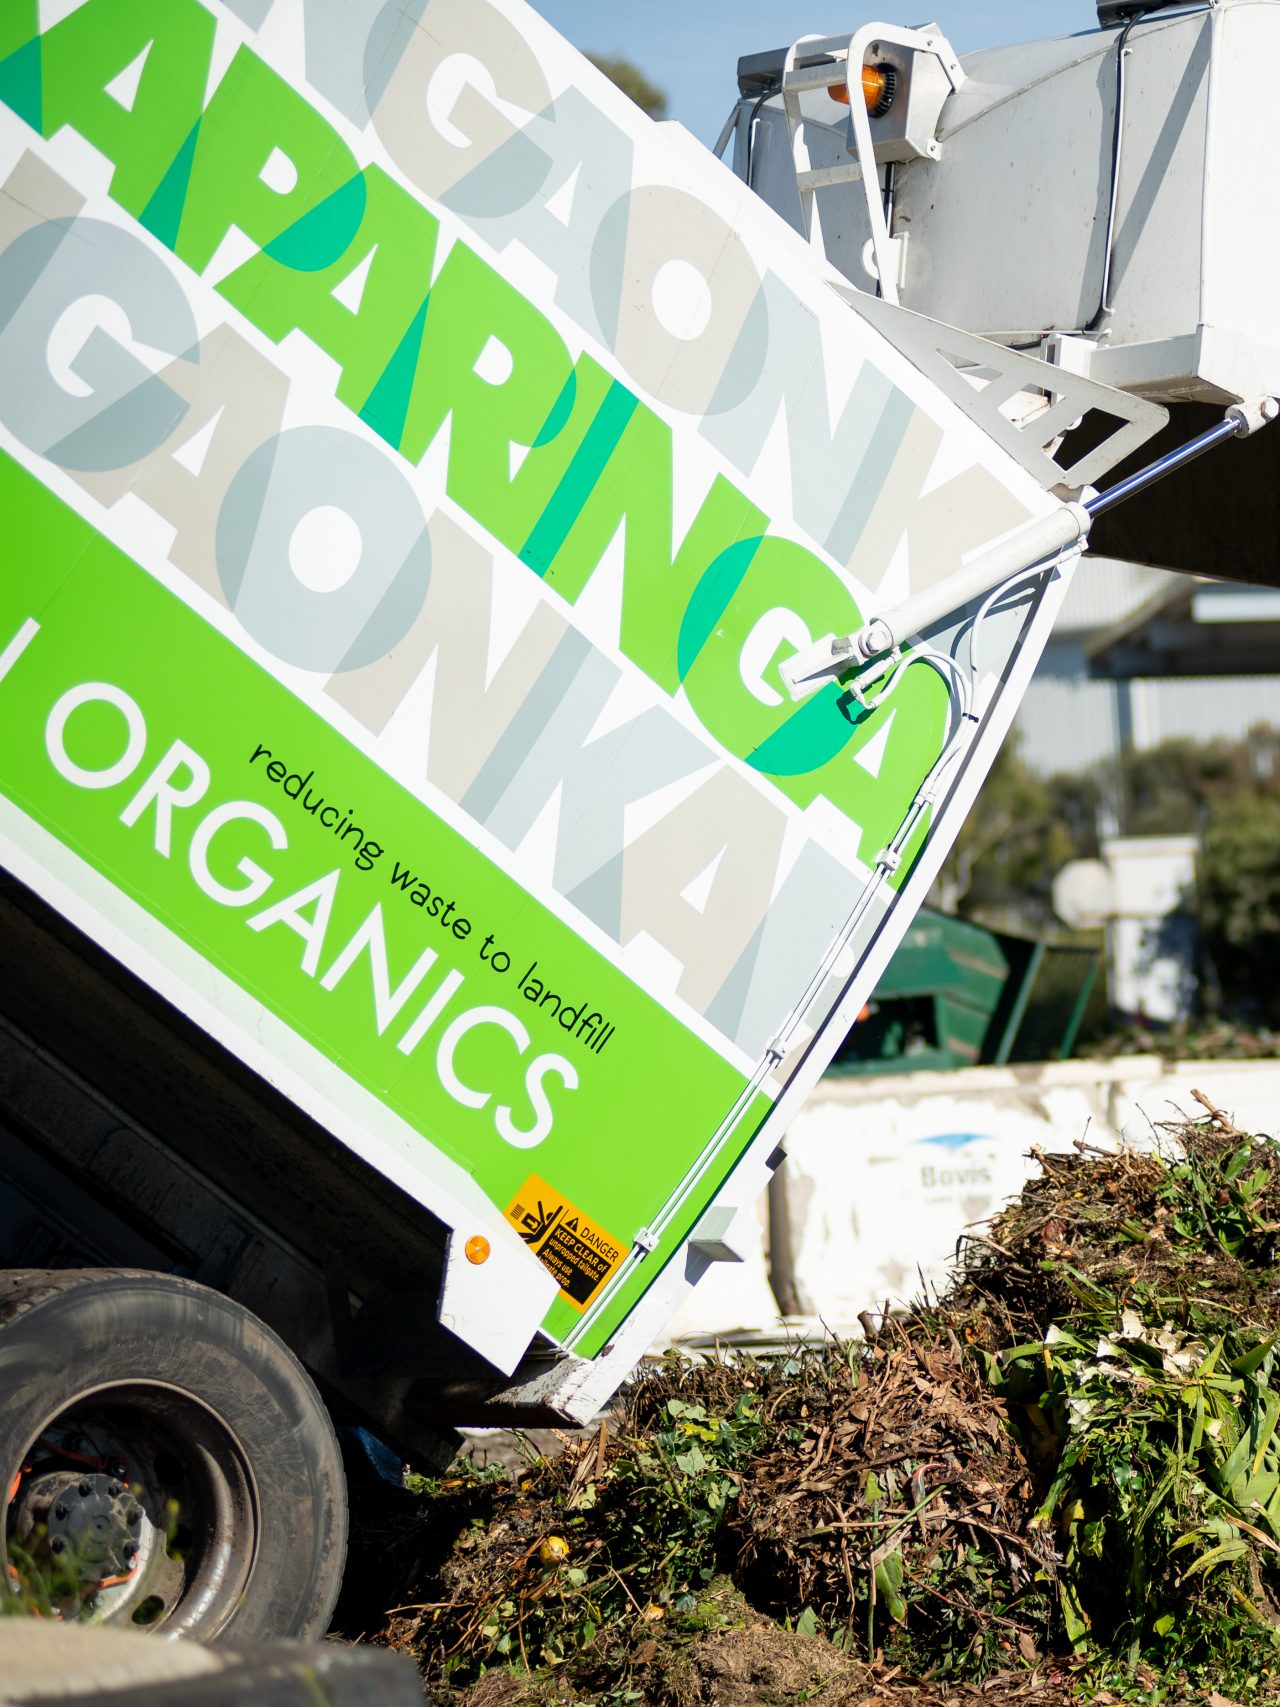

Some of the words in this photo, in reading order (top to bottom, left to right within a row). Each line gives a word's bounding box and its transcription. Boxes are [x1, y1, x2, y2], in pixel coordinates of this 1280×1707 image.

[0, 0, 952, 893] APARINGA
[45, 682, 579, 1149] ORGANICS
[249, 743, 383, 872] reducing
[390, 862, 472, 941] waste
[480, 933, 511, 974] to
[518, 961, 616, 1055] landfill
[921, 1164, 993, 1188] Bovis
[542, 1248, 563, 1268] Always
[561, 1264, 573, 1276] use
[549, 1238, 580, 1265] unpropped
[578, 1260, 599, 1282] tailgate.
[555, 1228, 575, 1246] KEEP
[574, 1243, 599, 1267] CLEAR
[597, 1264, 607, 1273] of
[580, 1227, 619, 1262] DANGER
[556, 1273, 571, 1288] prop.
